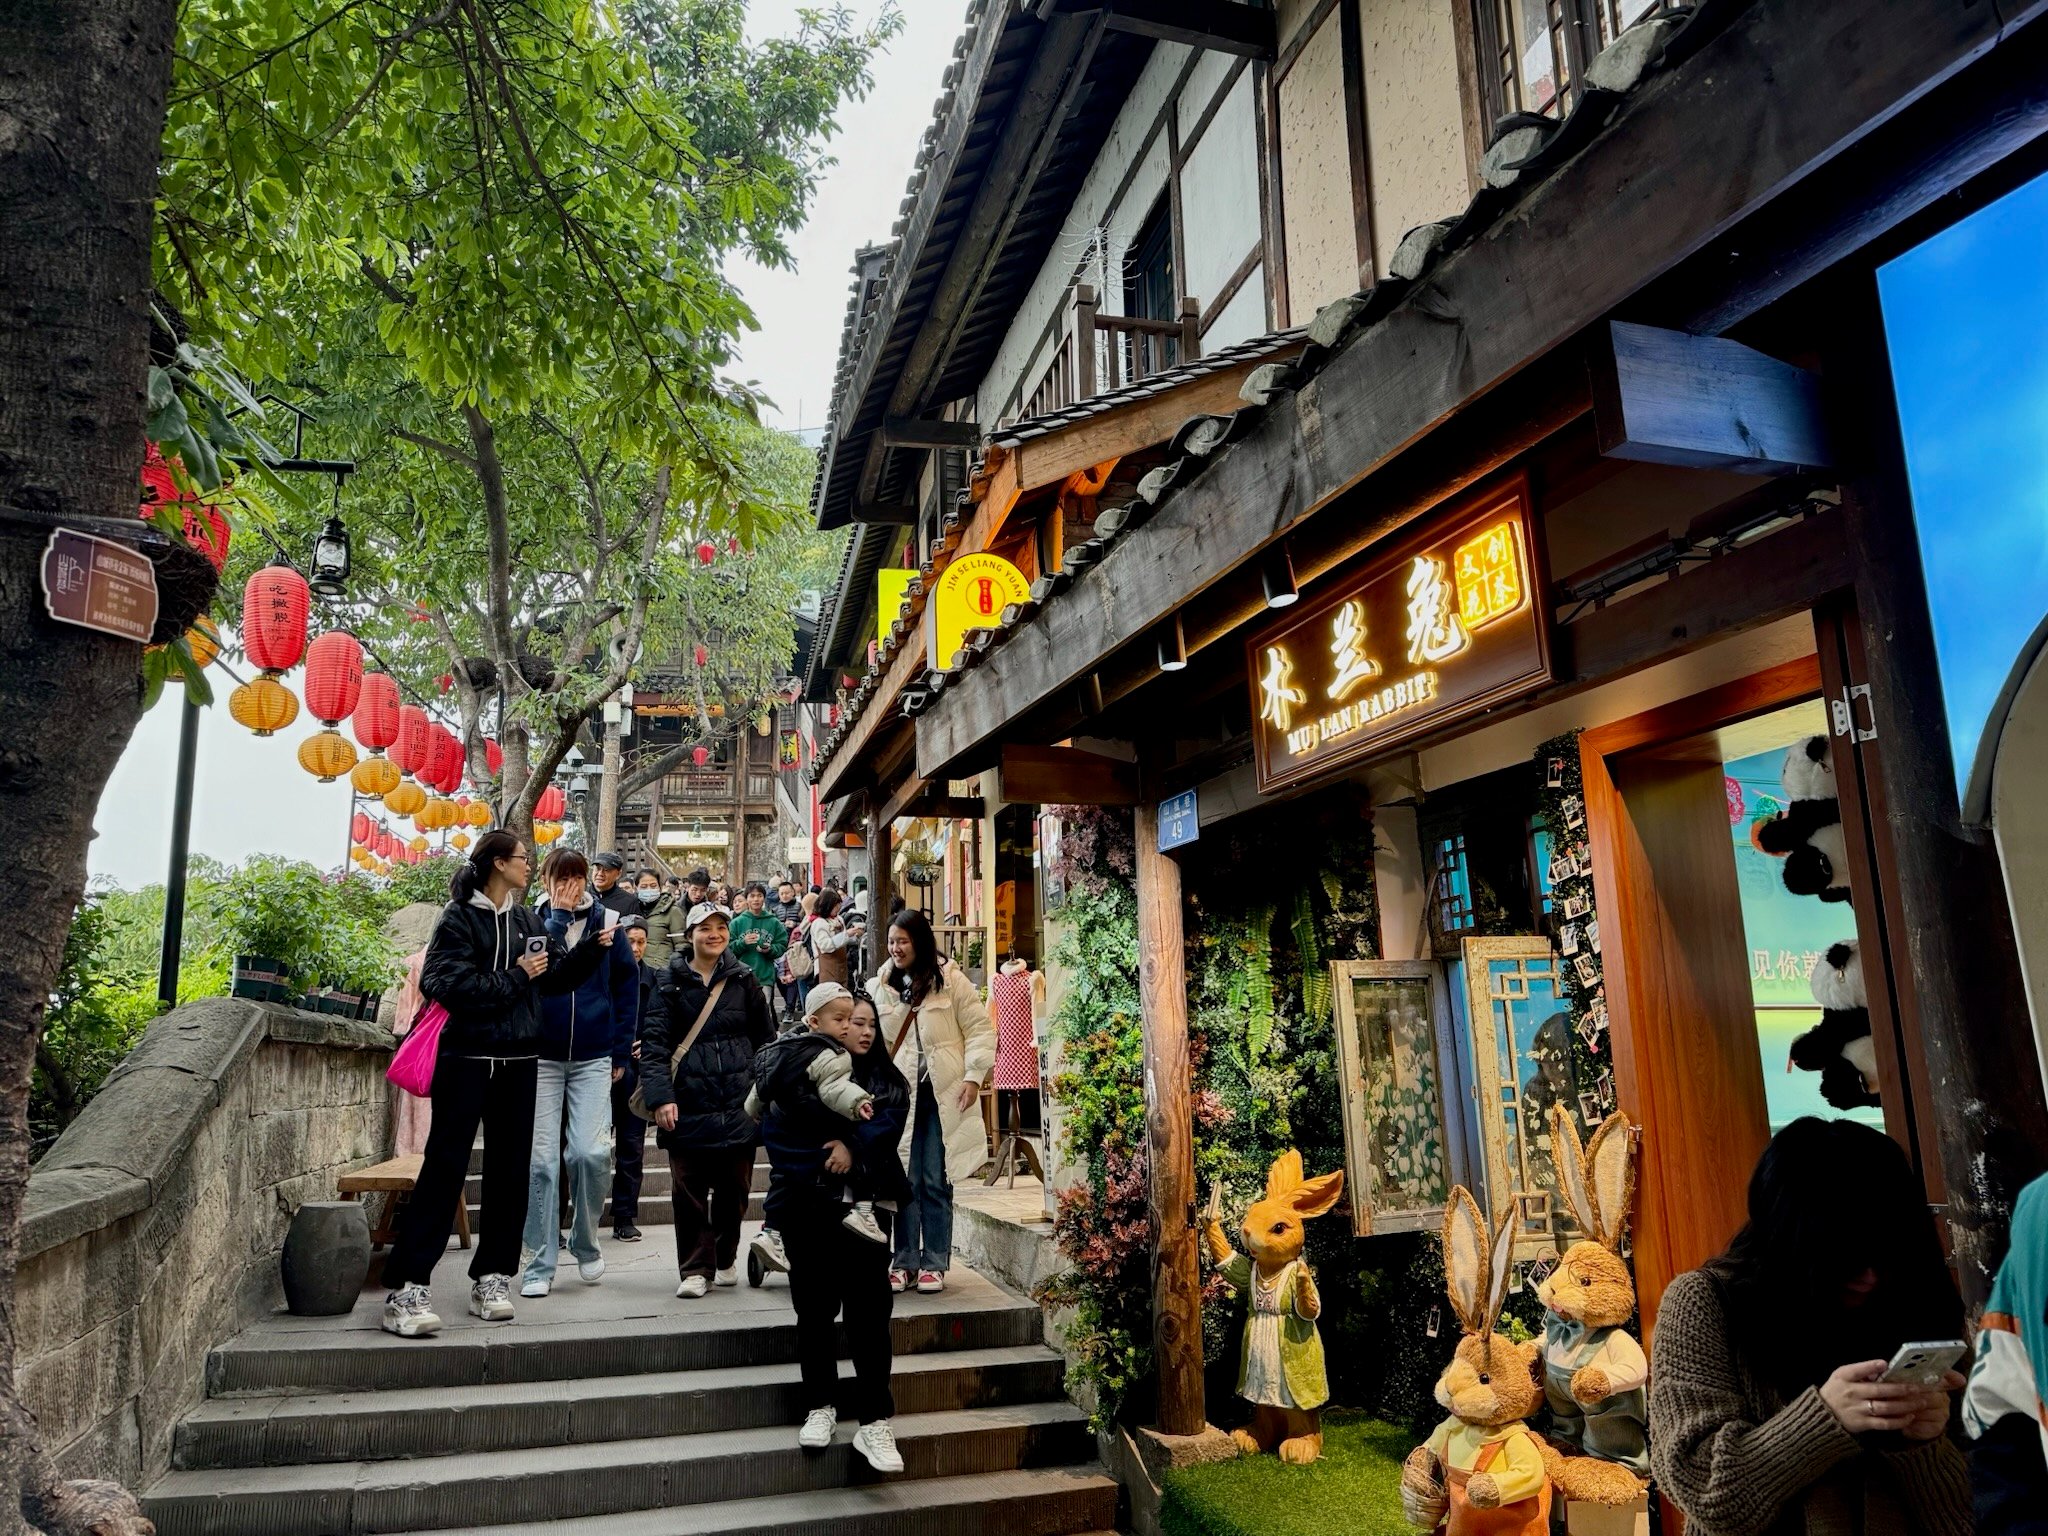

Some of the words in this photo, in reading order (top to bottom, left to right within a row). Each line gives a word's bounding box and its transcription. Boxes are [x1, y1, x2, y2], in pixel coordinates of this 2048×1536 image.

[946, 574, 959, 591] JIN
[958, 563, 969, 575] SE
[970, 559, 1003, 572] LIANG
[1005, 570, 1023, 598] YUAN
[1260, 555, 1468, 731] 木兰兔
[1288, 726, 1317, 756] MU
[1319, 704, 1357, 742] LAN
[1358, 671, 1437, 727] RABBIT
[1171, 820, 1183, 841] 49
